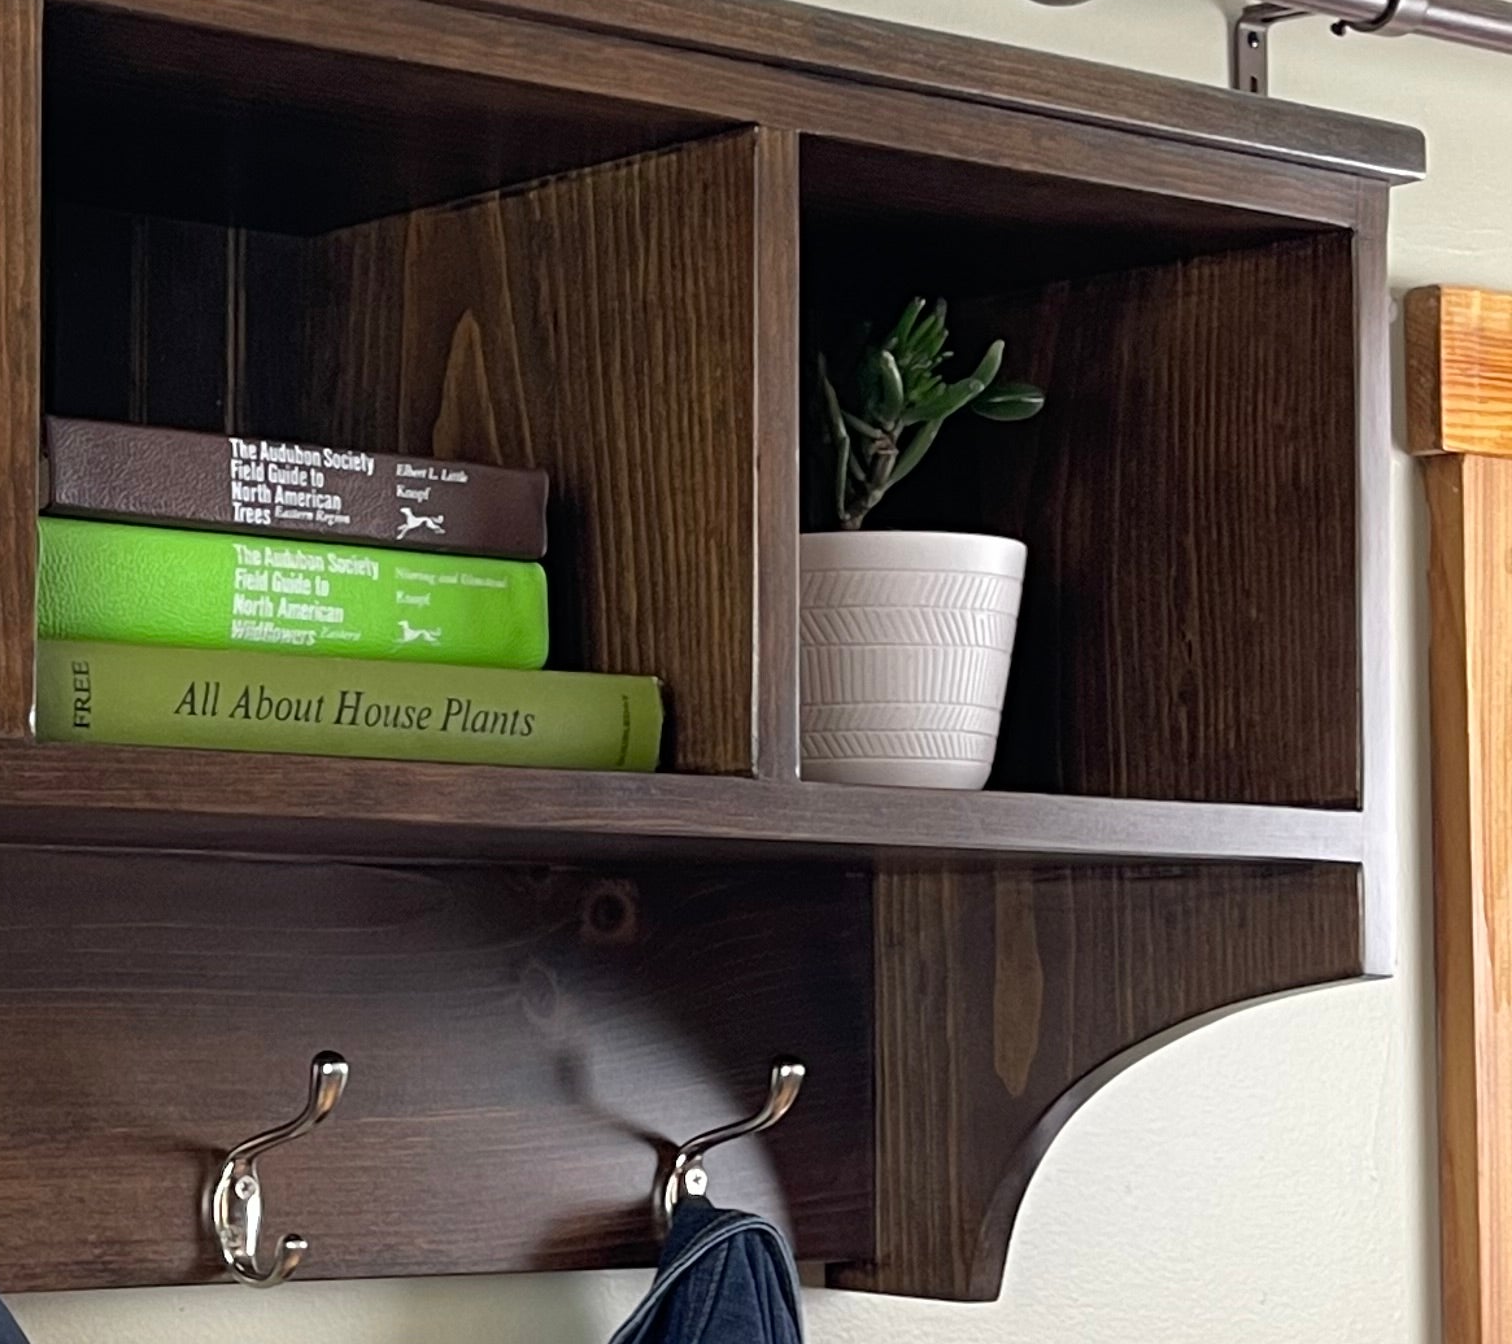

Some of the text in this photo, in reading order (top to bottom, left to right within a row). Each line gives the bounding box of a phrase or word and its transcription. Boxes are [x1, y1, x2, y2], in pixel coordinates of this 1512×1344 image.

[229, 437, 375, 476] The Audubon Society
[231, 458, 325, 488] Field Guide to
[231, 481, 342, 513] North American
[232, 502, 271, 525] Trees
[232, 544, 380, 581] The Audubon Society
[235, 567, 330, 597] Field Guide to
[233, 592, 344, 624] North American
[231, 618, 317, 647] Wildflowers
[71, 660, 92, 729] FREE
[173, 681, 536, 738] All About House Plants
